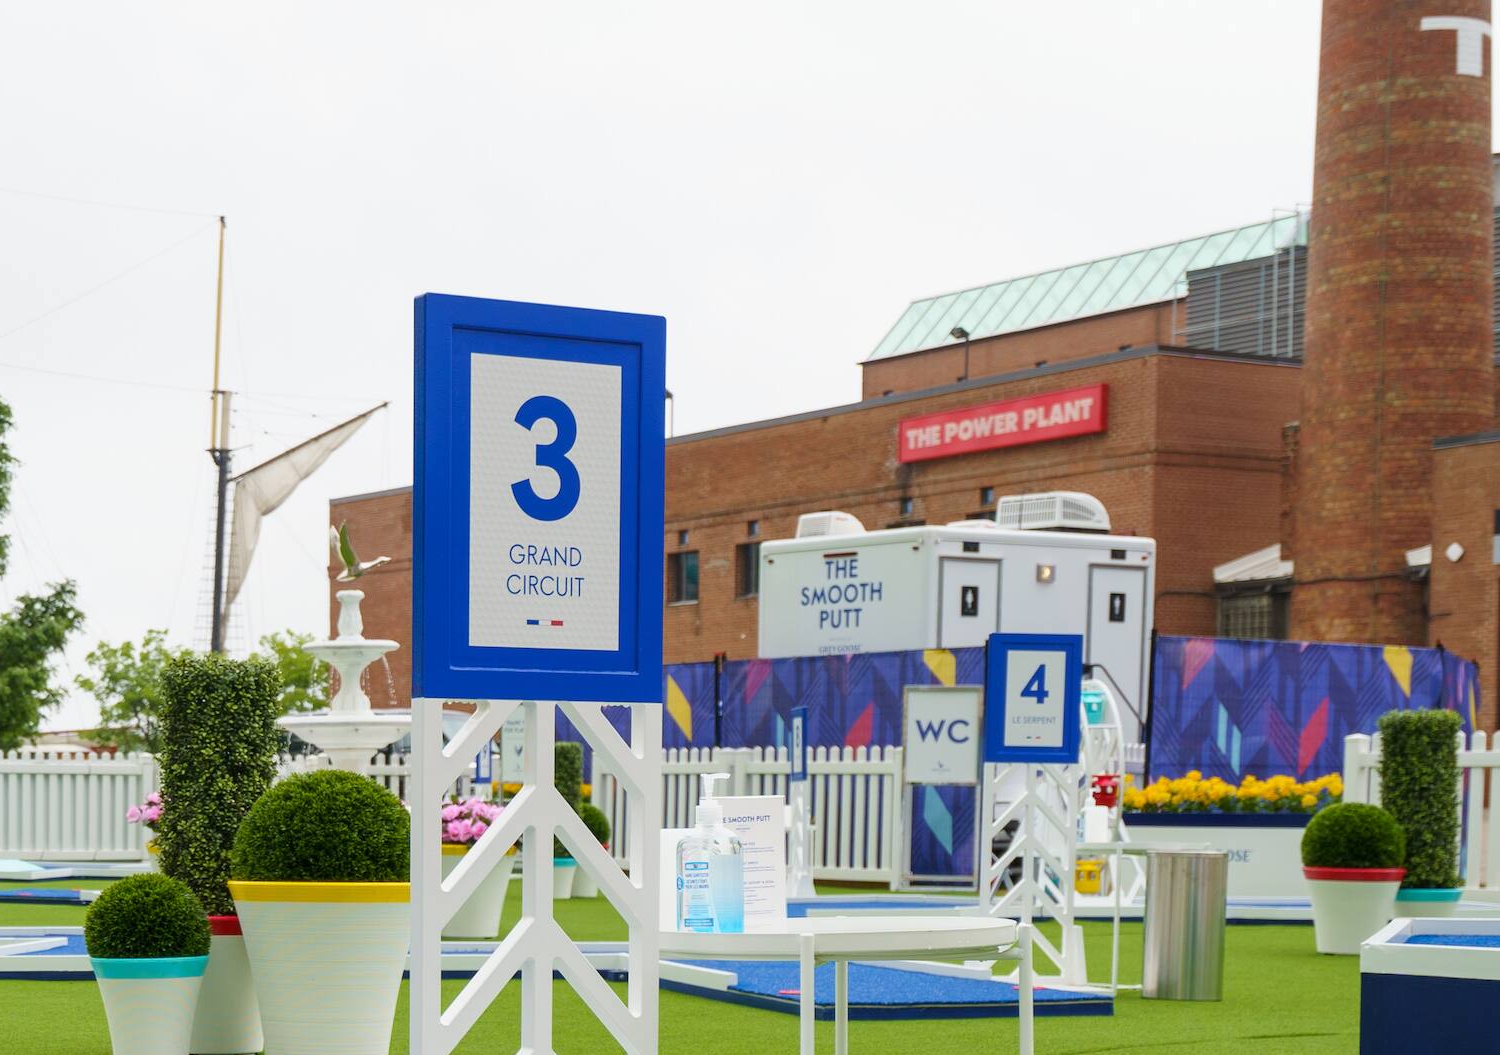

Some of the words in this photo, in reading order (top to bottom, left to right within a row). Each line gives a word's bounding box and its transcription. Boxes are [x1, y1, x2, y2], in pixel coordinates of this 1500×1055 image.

[906, 425, 941, 449] THE
[944, 412, 1018, 443] POWER
[1022, 398, 1093, 431] PLANT
[510, 395, 581, 521] 3
[508, 544, 583, 567] GRAND
[825, 559, 858, 580] THE
[506, 574, 585, 597] CIRCUIT
[801, 582, 883, 606] SMOOTH
[819, 608, 863, 629] PUTT
[1020, 664, 1049, 704] 4
[916, 719, 970, 744] WC
[1012, 716, 1021, 725] LE
[1023, 715, 1056, 725] SERPENT
[728, 815, 755, 823] SMOOTH
[756, 814, 771, 822] PUTT
